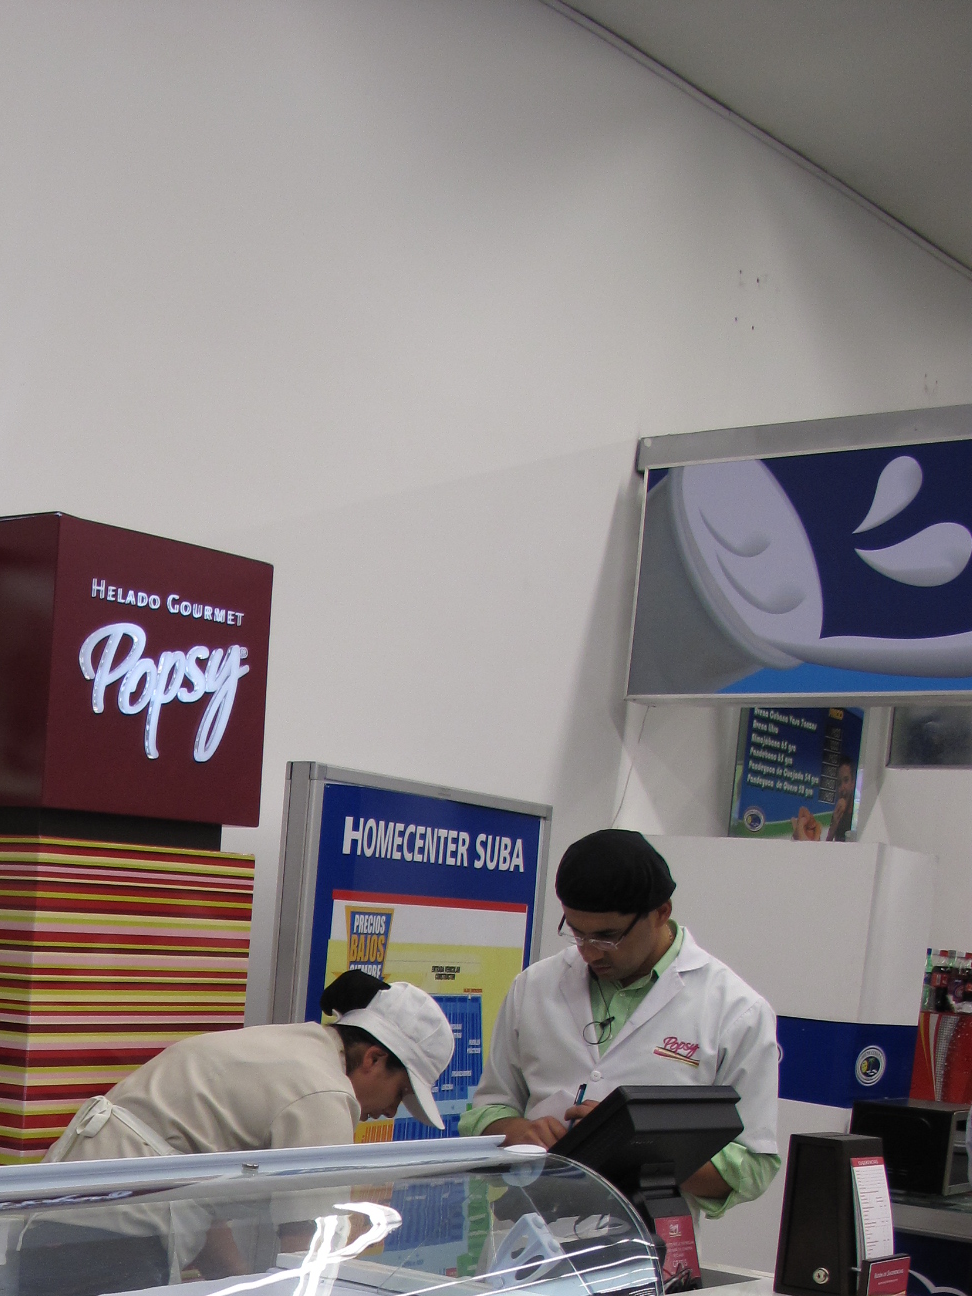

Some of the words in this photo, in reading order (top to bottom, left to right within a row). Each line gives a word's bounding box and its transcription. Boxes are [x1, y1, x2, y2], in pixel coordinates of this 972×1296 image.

[91, 577, 160, 609] HELADO
[166, 594, 244, 627] GOURMET
[79, 622, 250, 763] Popsy
[342, 816, 469, 867] HOMECENTER
[474, 833, 524, 873] SUBA
[353, 914, 386, 935] PRECIOS
[349, 934, 385, 963] BAJOS
[663, 1036, 699, 1059] Popsy
